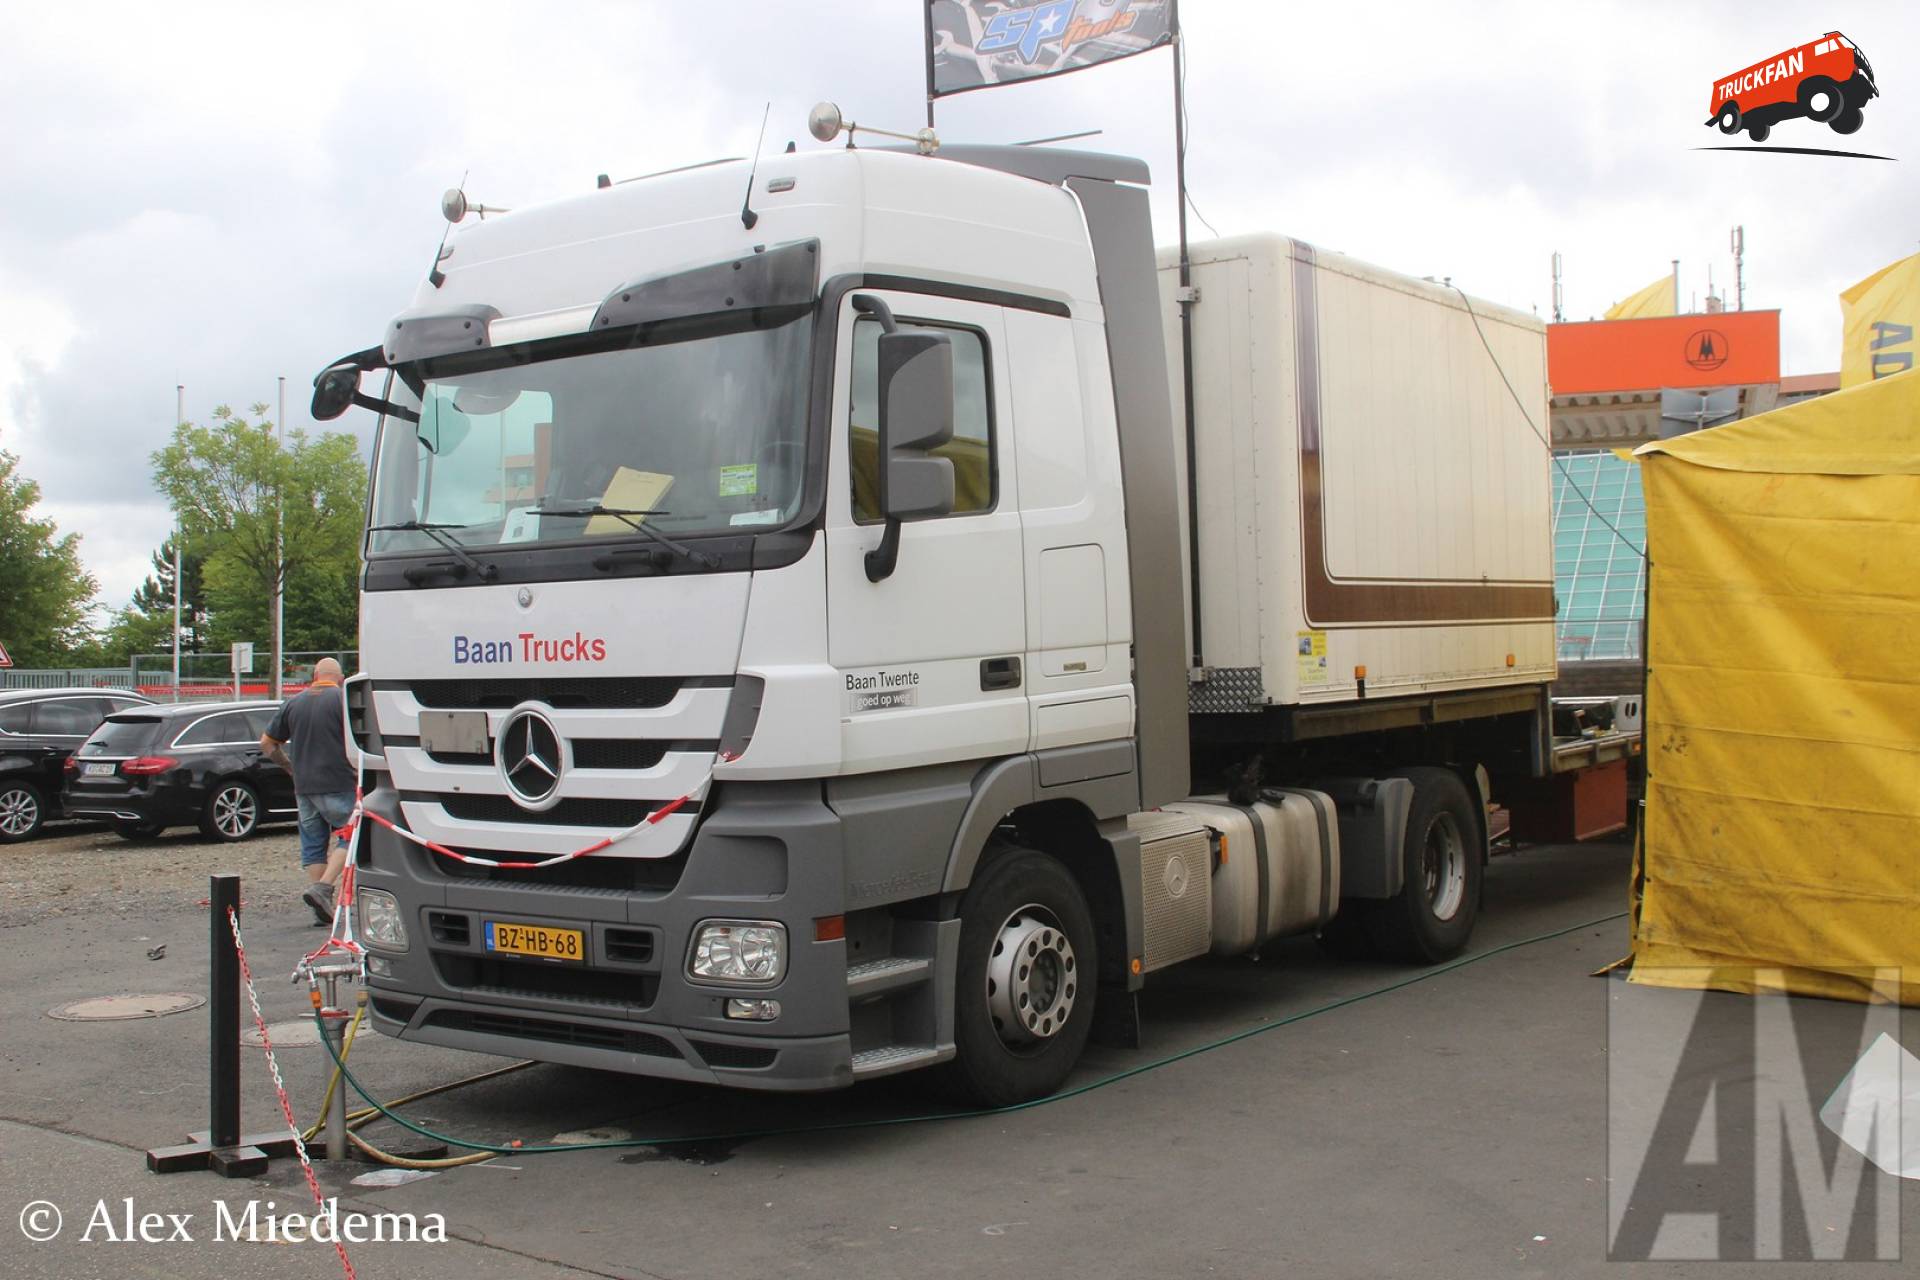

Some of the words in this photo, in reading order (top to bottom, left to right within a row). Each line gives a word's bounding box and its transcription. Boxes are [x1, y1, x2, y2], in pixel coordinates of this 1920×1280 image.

[454, 635, 513, 664] Baan
[518, 632, 606, 662] Trucks
[846, 674, 876, 690] Baan
[879, 671, 919, 687] Twente
[857, 694, 879, 710] goed
[881, 695, 892, 707] op
